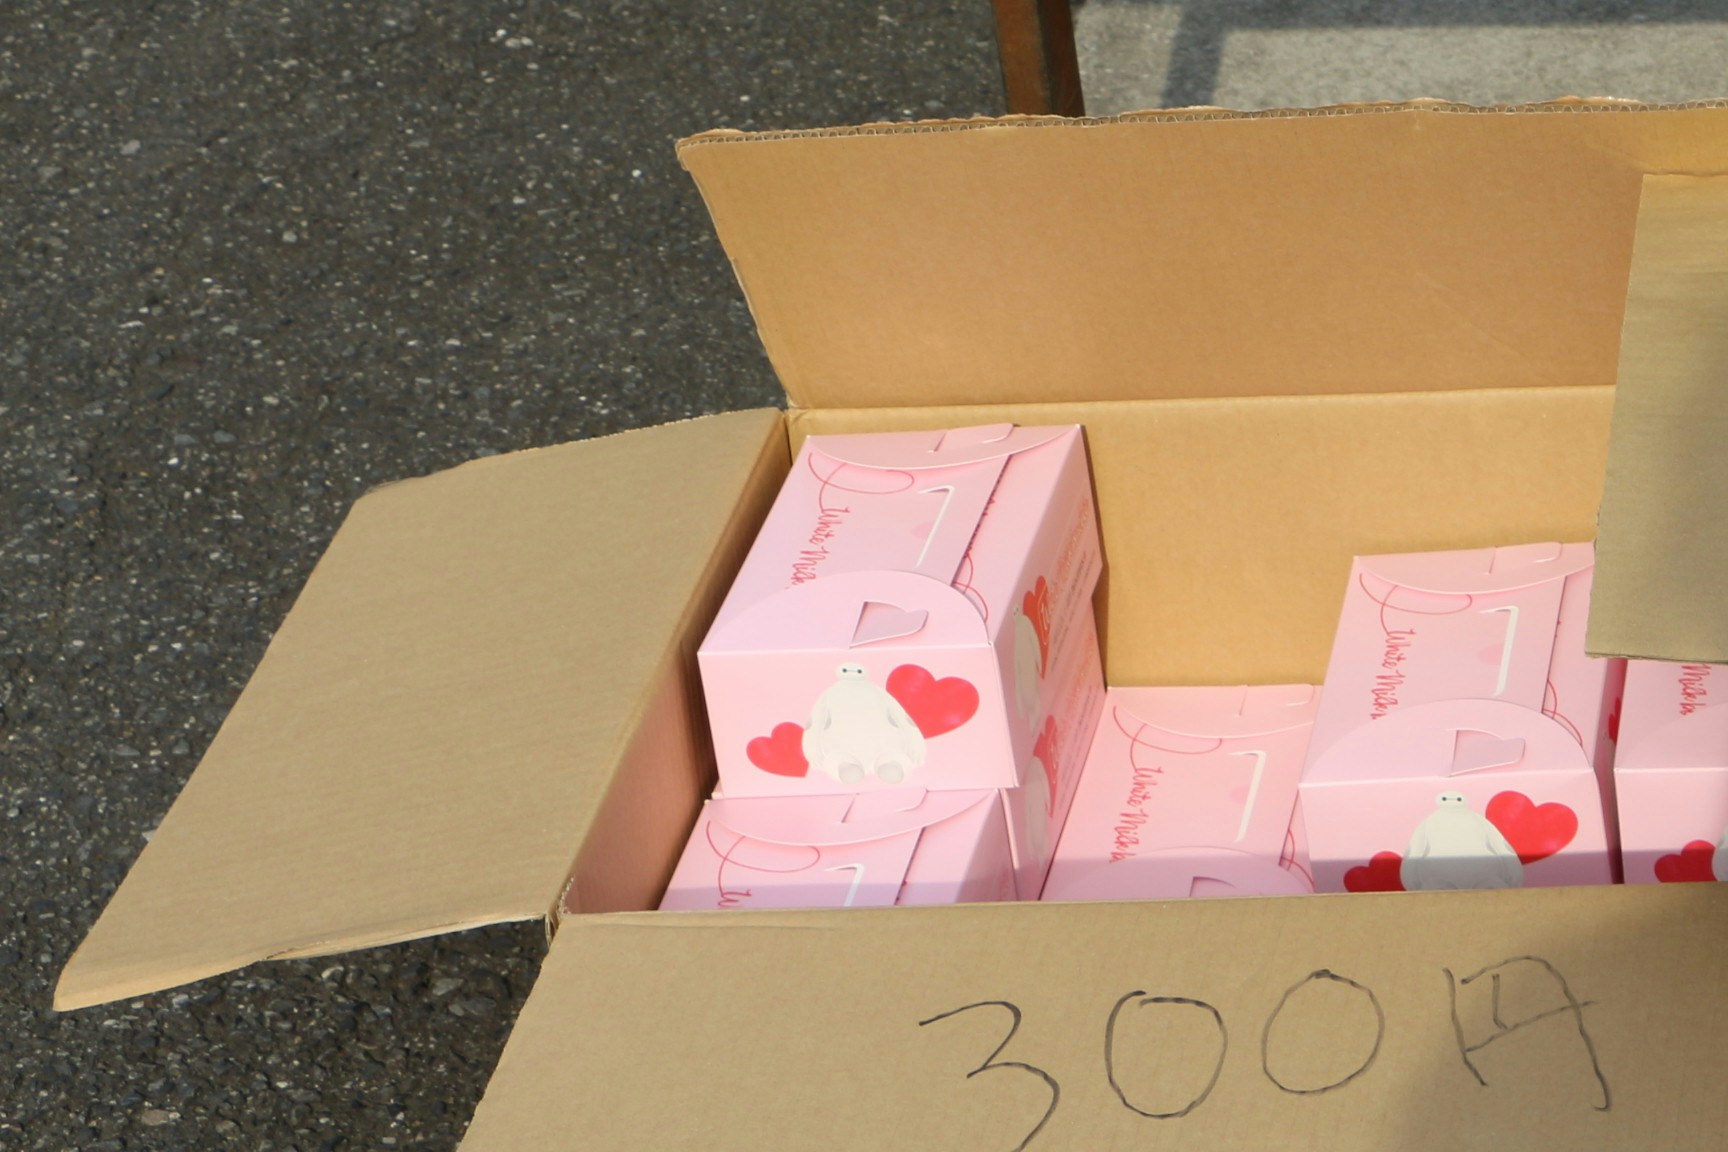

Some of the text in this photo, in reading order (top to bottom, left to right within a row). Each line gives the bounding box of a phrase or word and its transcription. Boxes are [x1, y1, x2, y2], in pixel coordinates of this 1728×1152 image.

[808, 505, 851, 546] White
[1381, 627, 1416, 669] White
[1127, 765, 1164, 808] White
[918, 954, 1611, 1152] 300円
